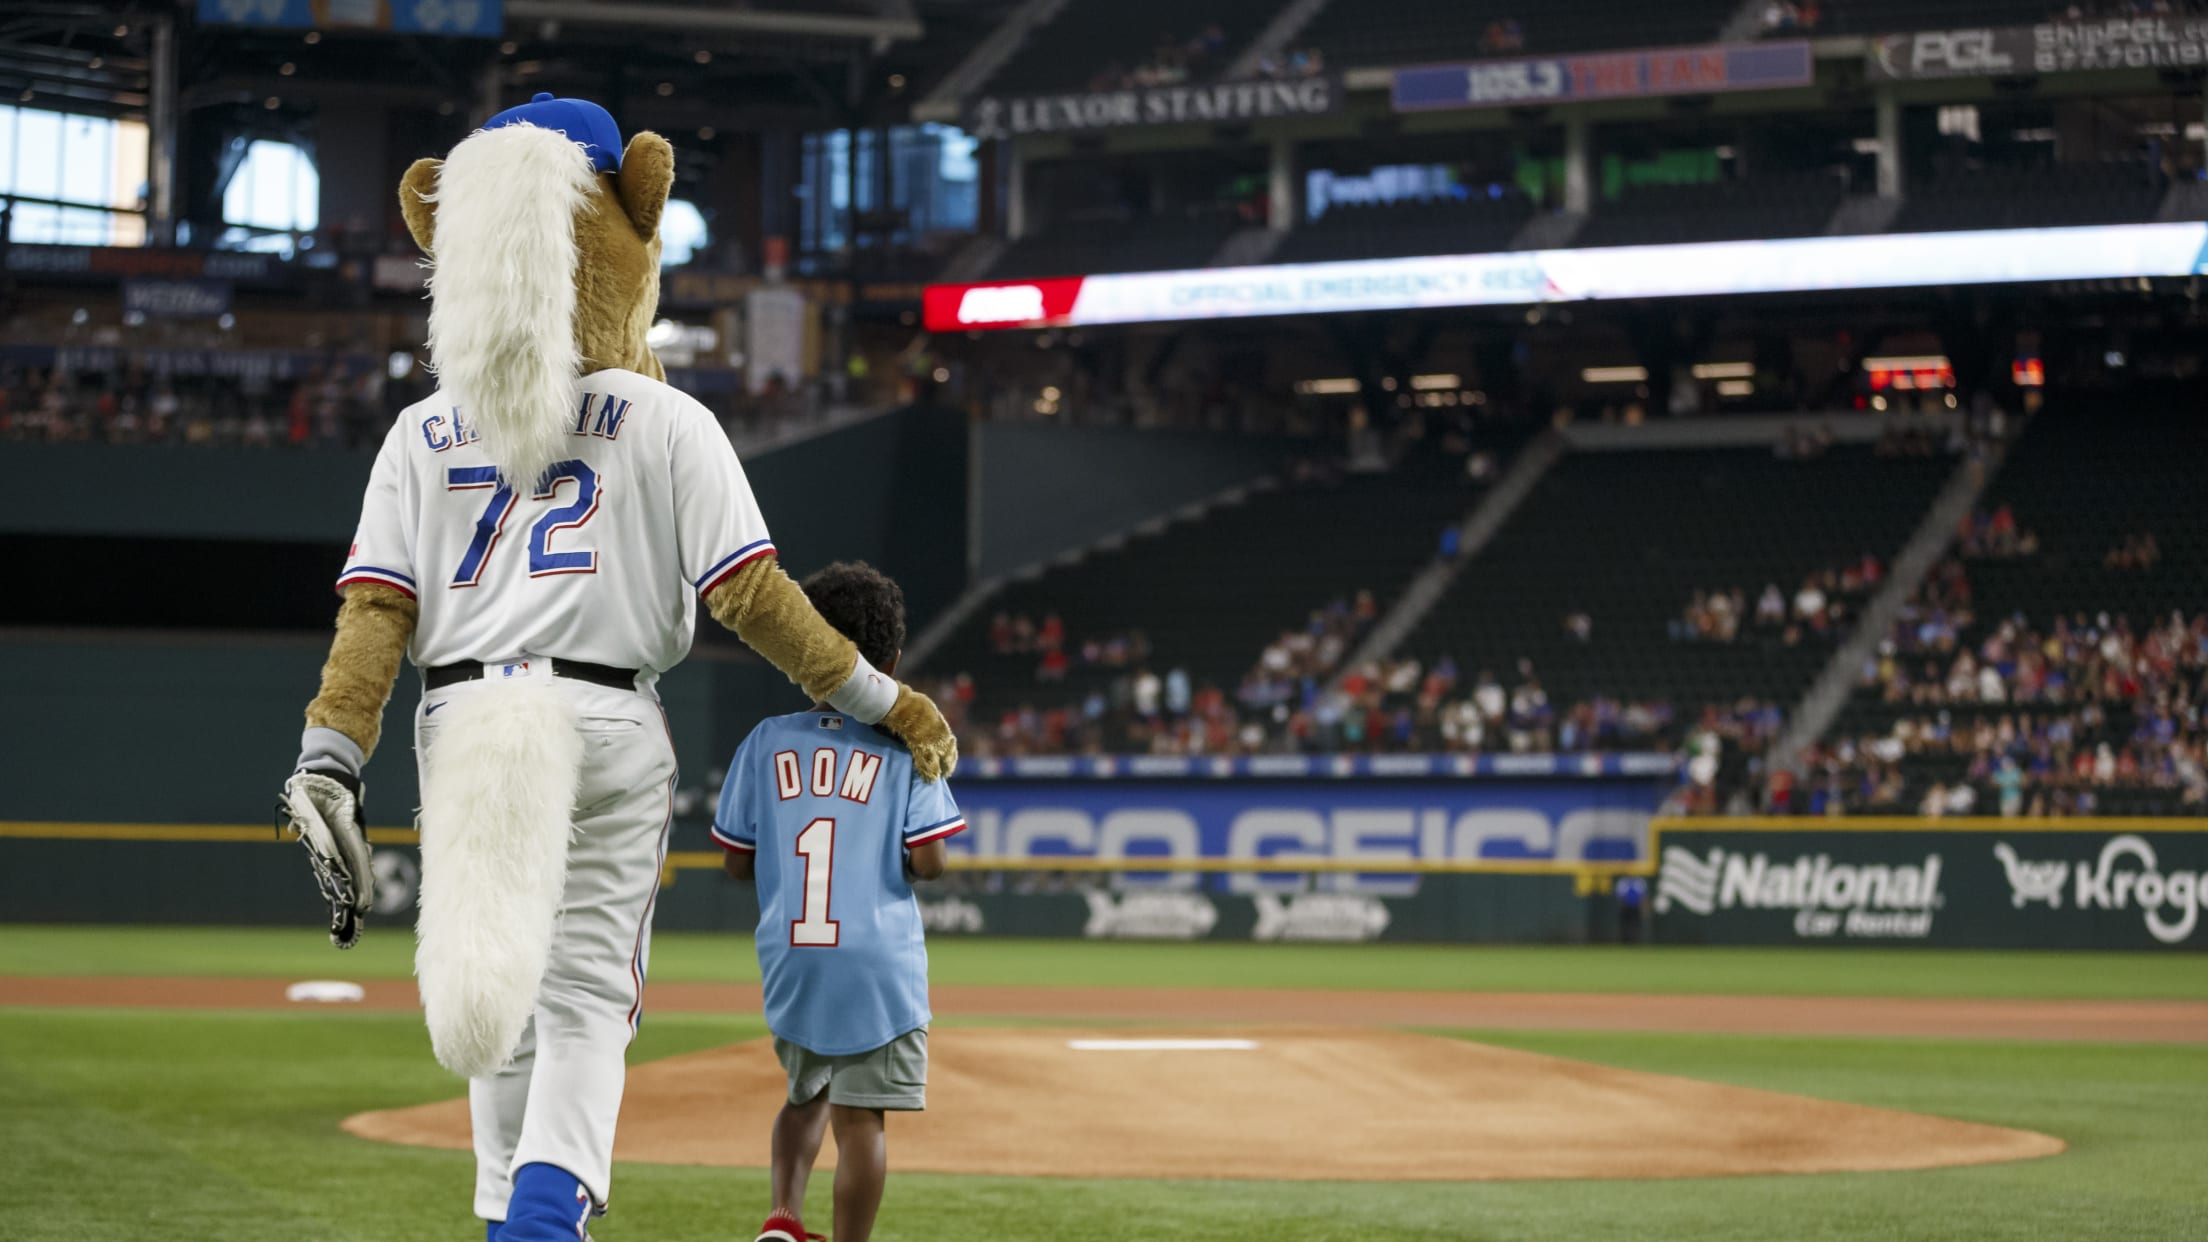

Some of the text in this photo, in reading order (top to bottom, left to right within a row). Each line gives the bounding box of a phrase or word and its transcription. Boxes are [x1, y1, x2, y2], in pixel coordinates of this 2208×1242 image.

[1468, 52, 1727, 102] 105.3 THE FAN
[1911, 29, 2013, 71] PGL
[1010, 78, 1330, 132] LUXOR STAFFING
[422, 392, 632, 452] CAIN
[446, 458, 602, 589] 72
[774, 747, 882, 805] DOM
[1227, 807, 1656, 894] GEICO
[790, 817, 840, 947] 1
[1718, 851, 1942, 910] National
[1793, 908, 1934, 938] Car Rental
